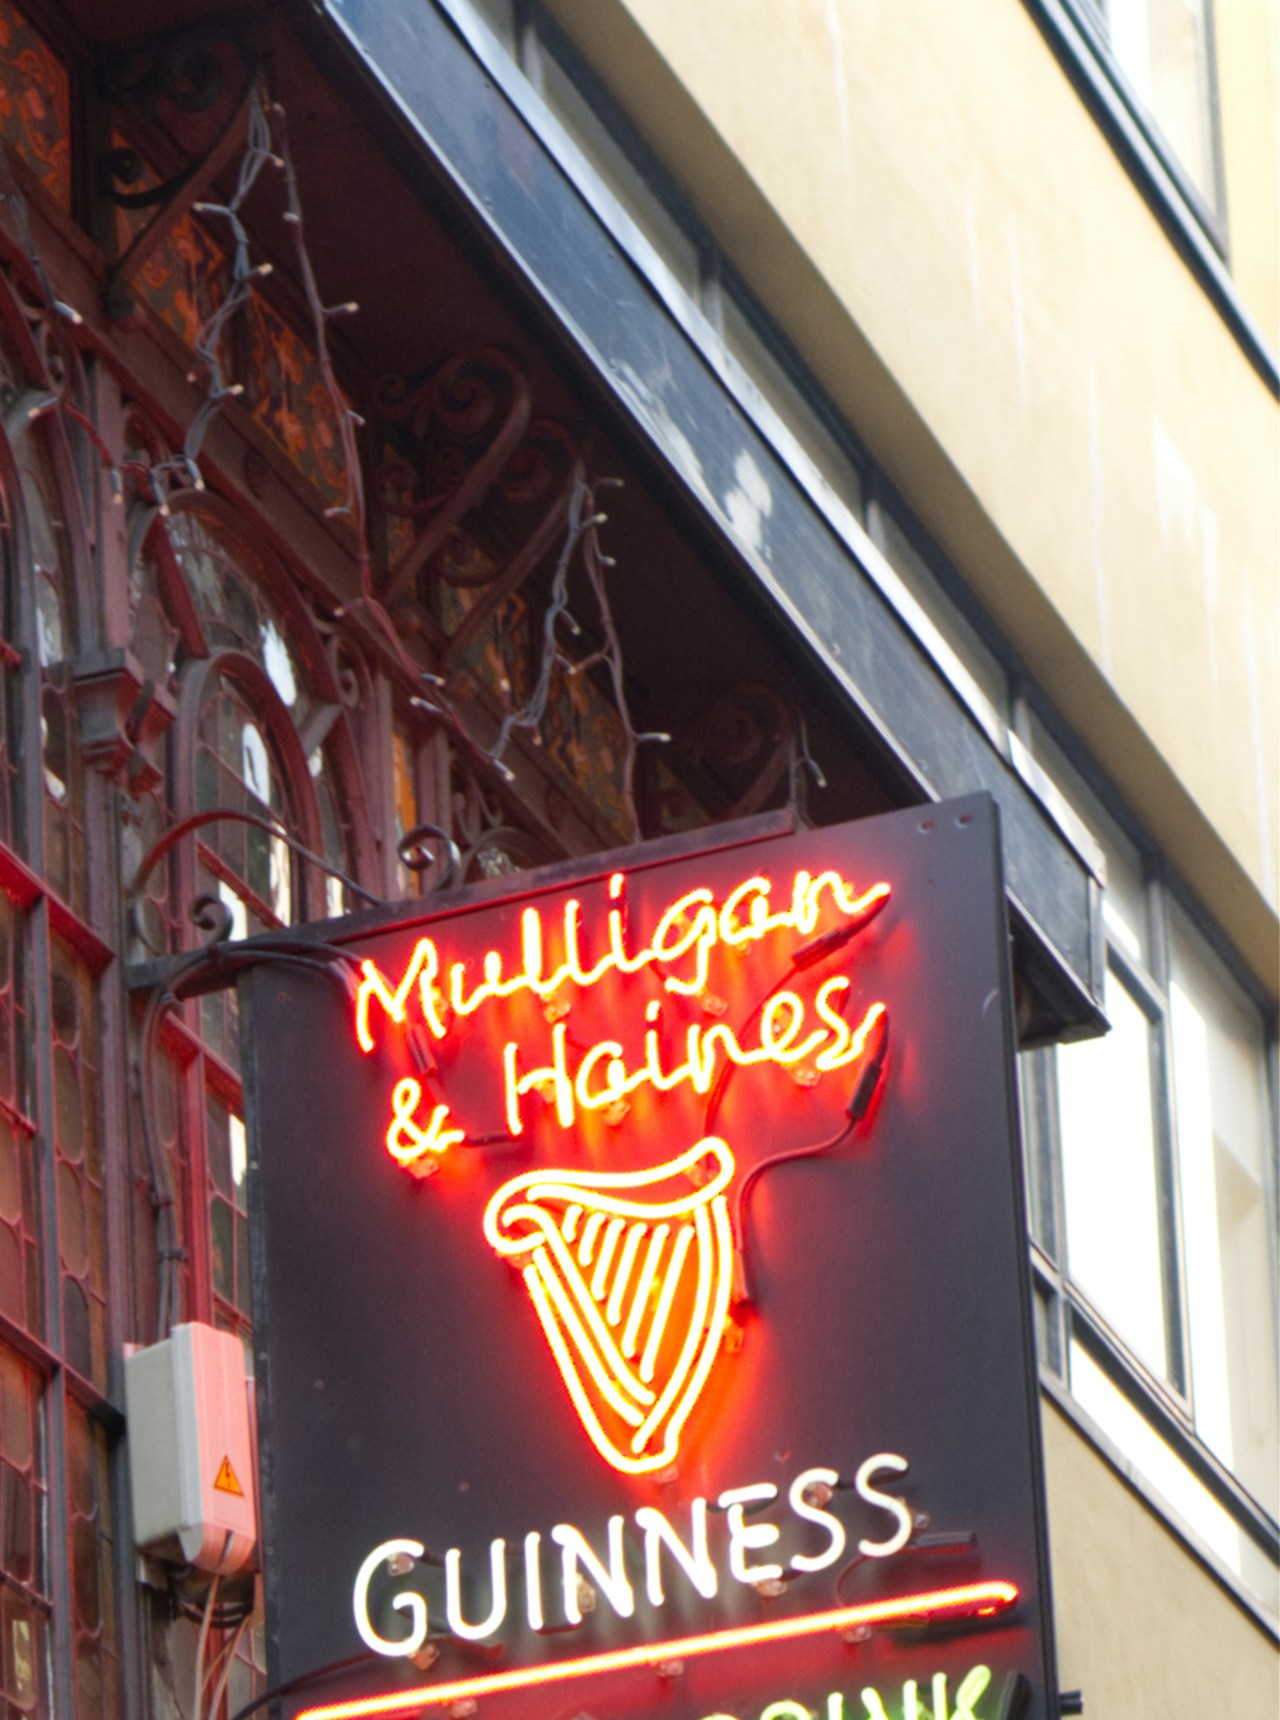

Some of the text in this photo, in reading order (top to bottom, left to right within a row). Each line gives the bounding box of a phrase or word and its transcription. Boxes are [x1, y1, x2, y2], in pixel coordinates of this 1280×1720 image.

[356, 873, 891, 1053] Mulligan
[386, 975, 887, 1160] & Haines
[352, 1452, 912, 1657] GUINNESS
